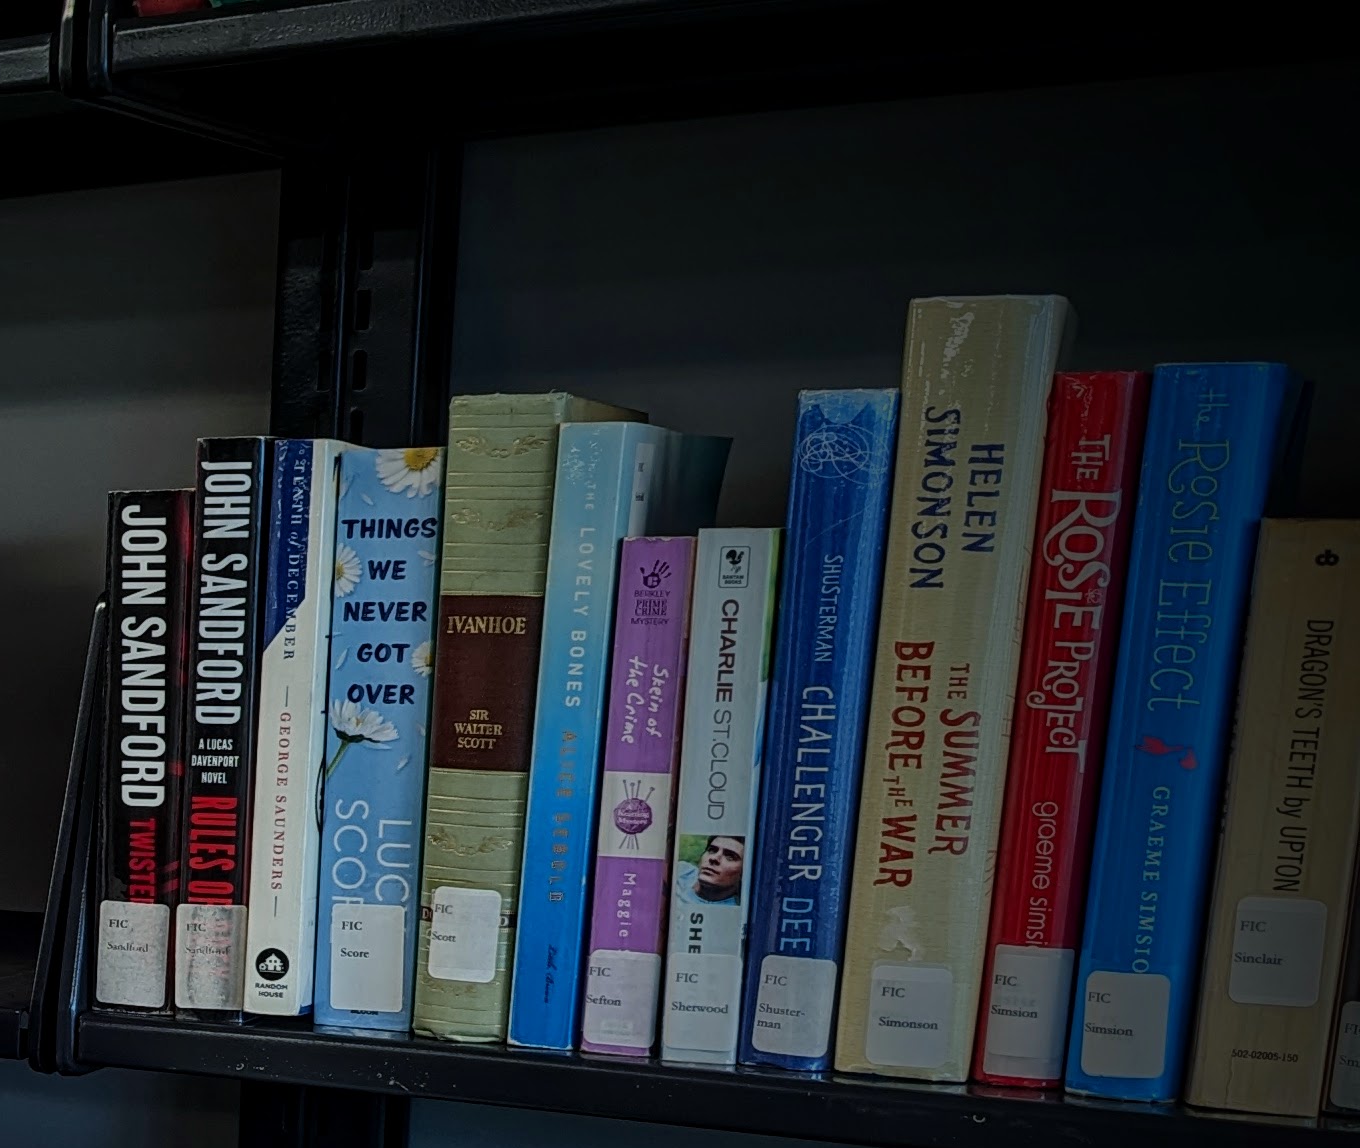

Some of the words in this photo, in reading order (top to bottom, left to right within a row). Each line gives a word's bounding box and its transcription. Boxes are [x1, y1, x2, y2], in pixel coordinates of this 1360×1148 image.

[1195, 387, 1232, 426] the
[1070, 433, 1111, 483] THE
[198, 460, 253, 541] JOHN
[909, 405, 961, 590] SIMONSON
[961, 443, 1005, 553] HELEN
[1167, 438, 1231, 565] Rosie
[341, 517, 438, 539] THINGS
[121, 504, 167, 606] JOHN
[368, 559, 407, 581] WE
[573, 527, 596, 617] LOVELY
[1043, 488, 1124, 631] ROSIE
[343, 601, 427, 623] NEVER
[446, 615, 527, 634] IVANHOE
[814, 554, 844, 662] SHUSTERMAN
[194, 552, 249, 726] SANDFORD
[357, 643, 411, 664] GOT
[717, 599, 740, 703] CHARLIE
[1146, 577, 1213, 713] Effect
[565, 630, 587, 708] BONES
[947, 662, 972, 700] THE
[120, 616, 167, 809] SANDFORD
[347, 684, 415, 705] OVER
[884, 640, 935, 772] BEFORE
[1026, 640, 1095, 756] PROJECT
[454, 723, 502, 736] WALTER
[469, 709, 489, 720] SIR
[191, 755, 240, 768] DAVENPORT
[199, 739, 205, 750] A
[207, 739, 234, 751] LUCAS
[277, 711, 291, 787] GEORGE
[457, 738, 496, 750] SCOTT
[201, 771, 228, 785] NOVEL
[787, 685, 837, 882] CHALLENGER
[883, 775, 913, 808] THE
[927, 707, 983, 856] SUMMER
[126, 817, 158, 904] TWISTE
[270, 795, 288, 891] SAUNDERS
[873, 814, 917, 888] WAR
[616, 872, 638, 939] Maggie
[779, 897, 814, 952] DEE
[341, 921, 363, 931] FIC
[431, 931, 457, 943] Scott
[340, 948, 369, 958] Score
[1233, 951, 1283, 967] Sinclair
[677, 971, 699, 984] FIC
[882, 986, 906, 999] FIC
[585, 993, 622, 1007] Sefton
[671, 1001, 730, 1015] Sherwood
[990, 1004, 1038, 1020] Simsion
[878, 1016, 939, 1031] Simonson
[1084, 1022, 1134, 1038] Simsion
[1231, 1048, 1299, 1064] 502-02005-150
